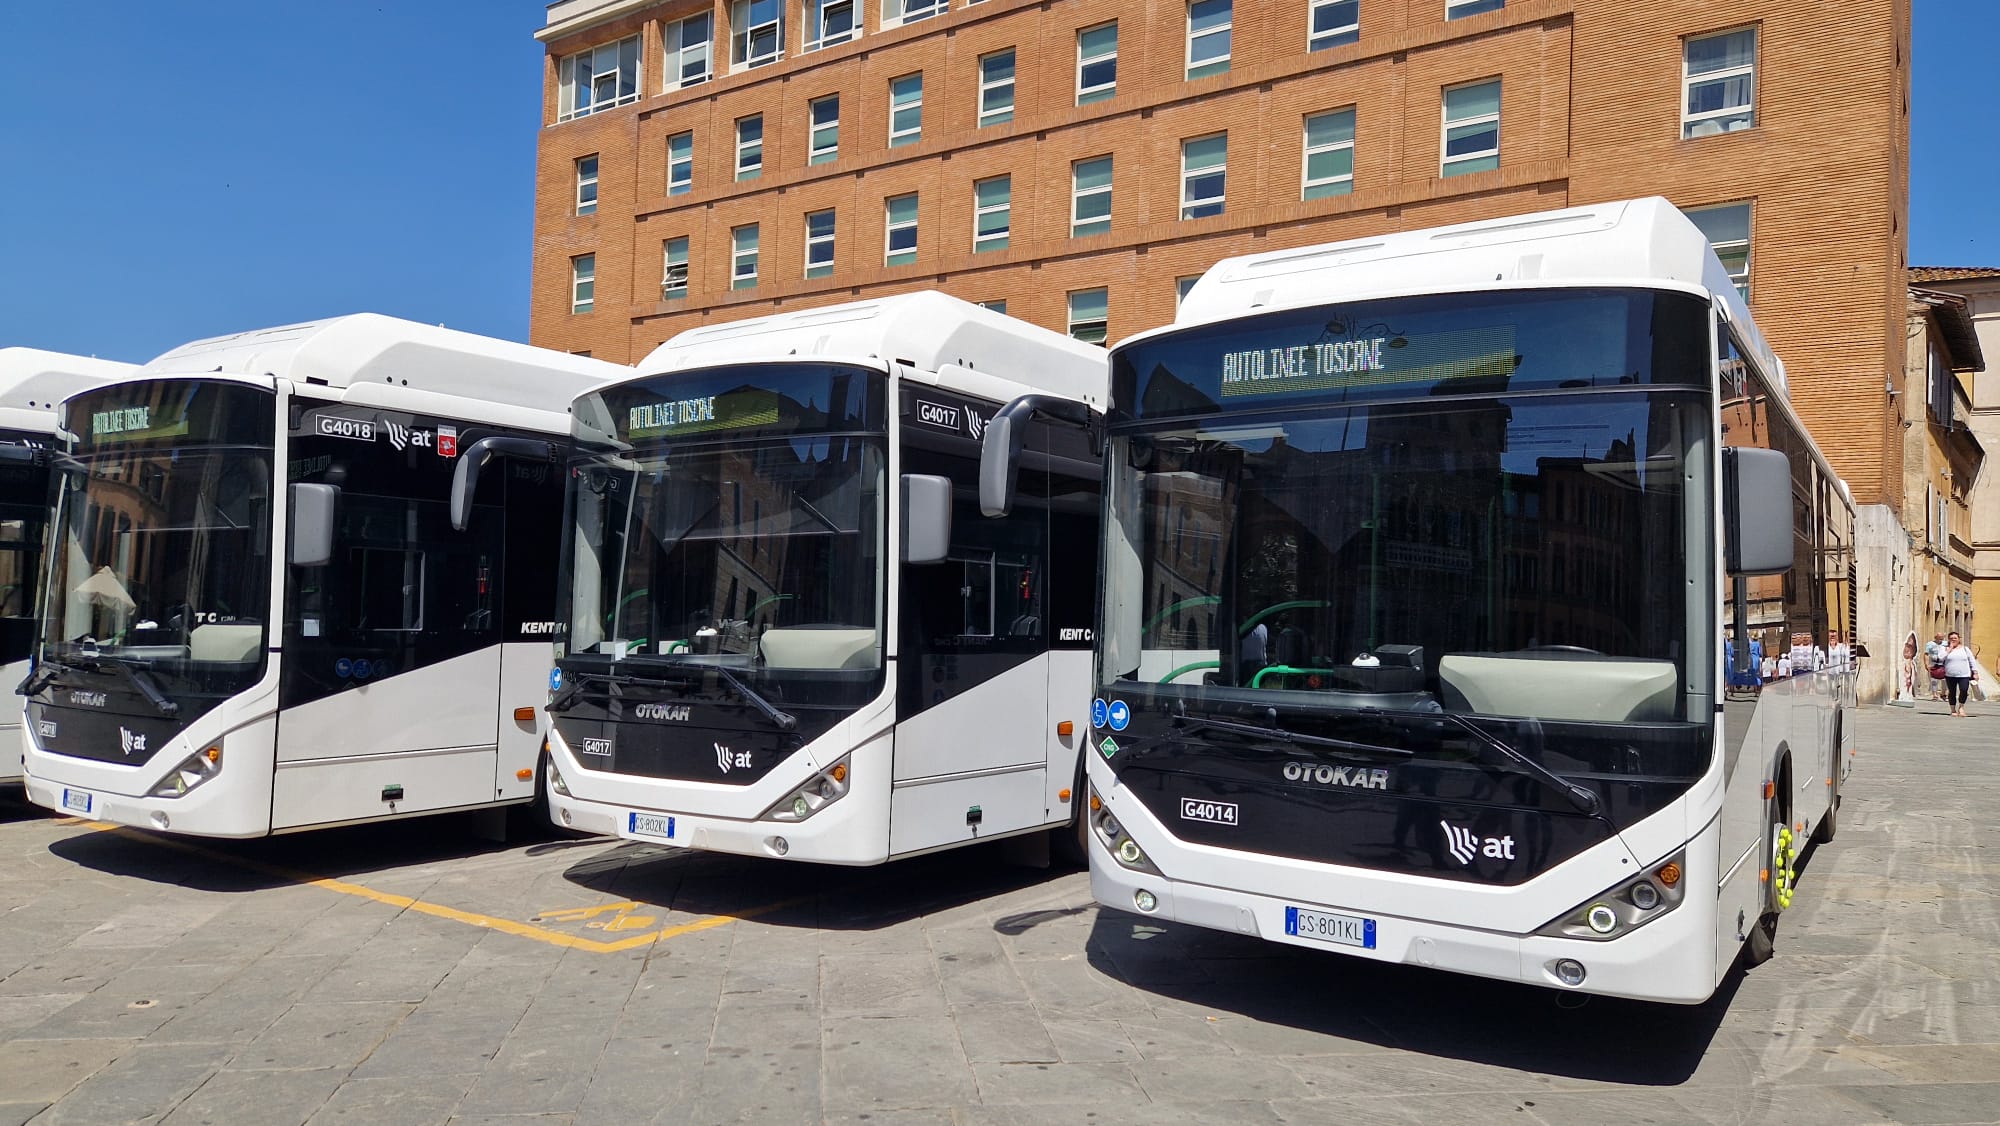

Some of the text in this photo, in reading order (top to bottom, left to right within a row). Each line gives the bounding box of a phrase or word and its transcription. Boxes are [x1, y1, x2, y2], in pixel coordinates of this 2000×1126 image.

[1223, 337, 1386, 383] AUTOLINEE TOSCANE
[921, 404, 957, 426] G4017
[321, 419, 372, 439] G4018
[411, 429, 432, 448] at
[520, 621, 556, 634] KENT
[1060, 627, 1084, 641] KENT
[133, 734, 146, 750] at
[584, 740, 610, 754] G4017
[734, 750, 752, 768] at
[1282, 761, 1390, 790] OTOKAR
[1184, 801, 1235, 822] G4014
[1482, 834, 1516, 861] at
